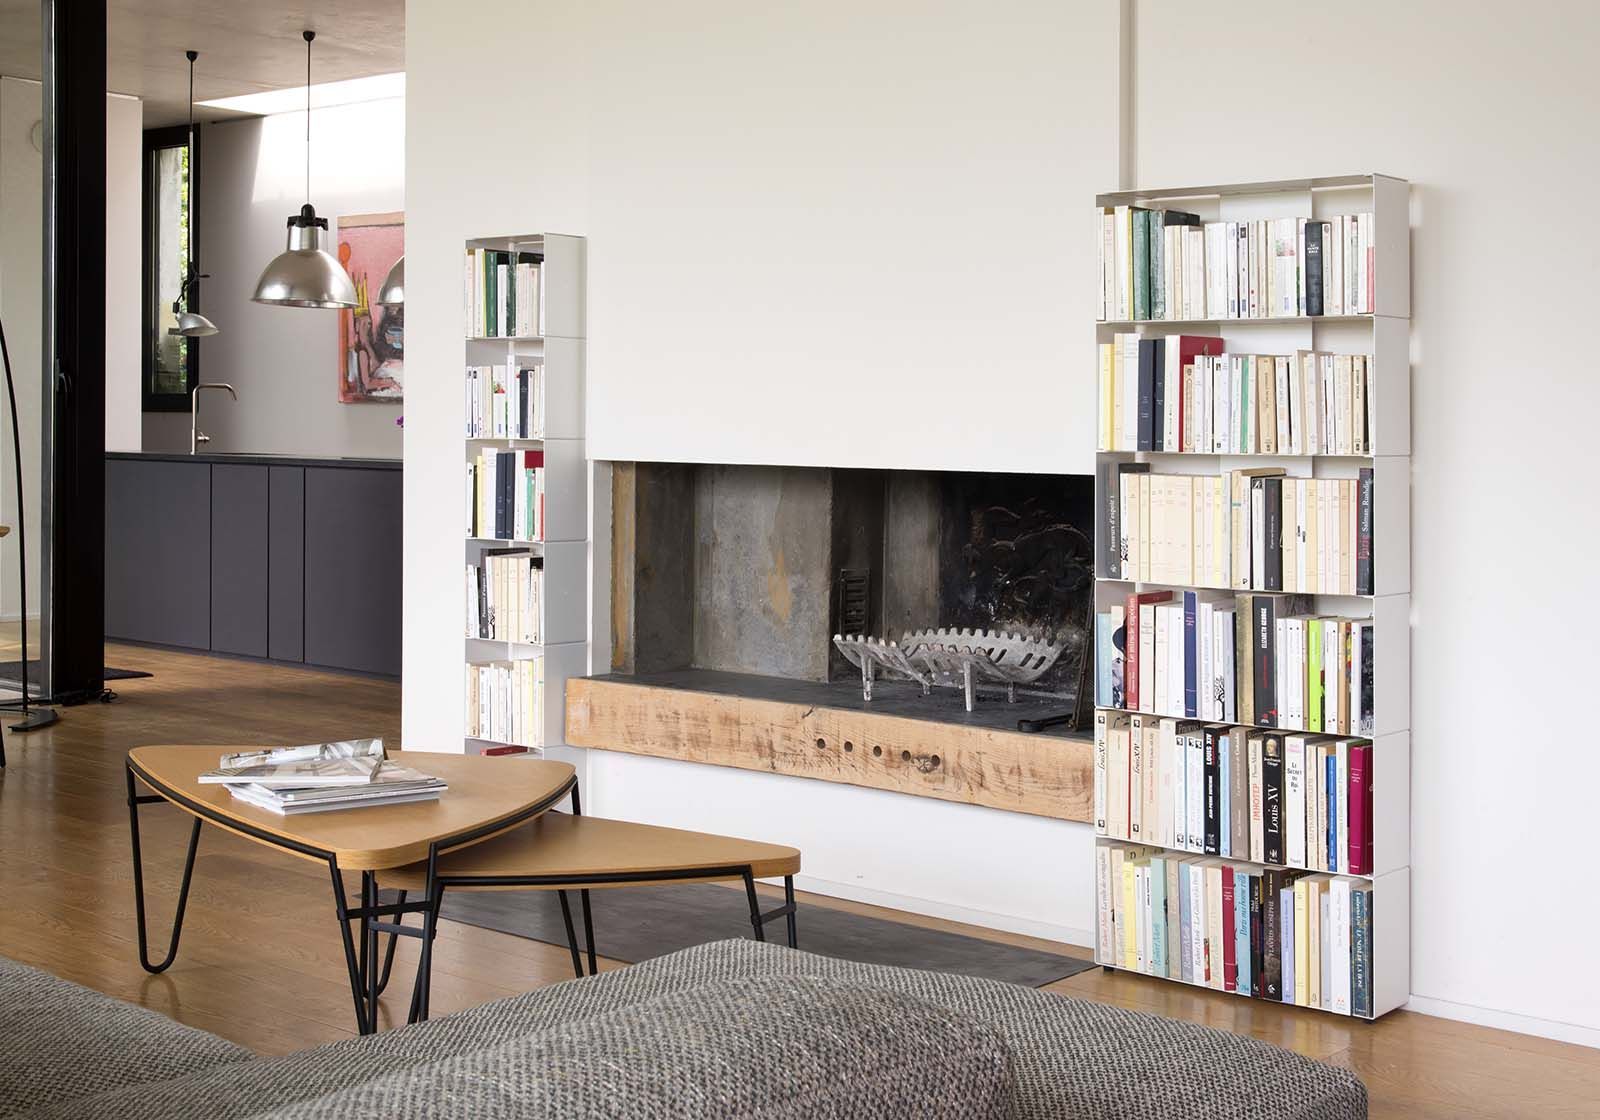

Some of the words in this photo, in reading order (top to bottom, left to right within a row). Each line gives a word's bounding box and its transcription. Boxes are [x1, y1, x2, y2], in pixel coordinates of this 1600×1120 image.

[1361, 480, 1370, 506] Rushdie
[1361, 508, 1369, 532] Salman
[1260, 626, 1268, 649] ELIZABETH
[1205, 733, 1213, 745] XIV
[1205, 746, 1213, 766] LOUIS
[1252, 783, 1261, 821] IMHOTEP
[1267, 784, 1278, 802] XV
[1267, 804, 1279, 833] Louis
